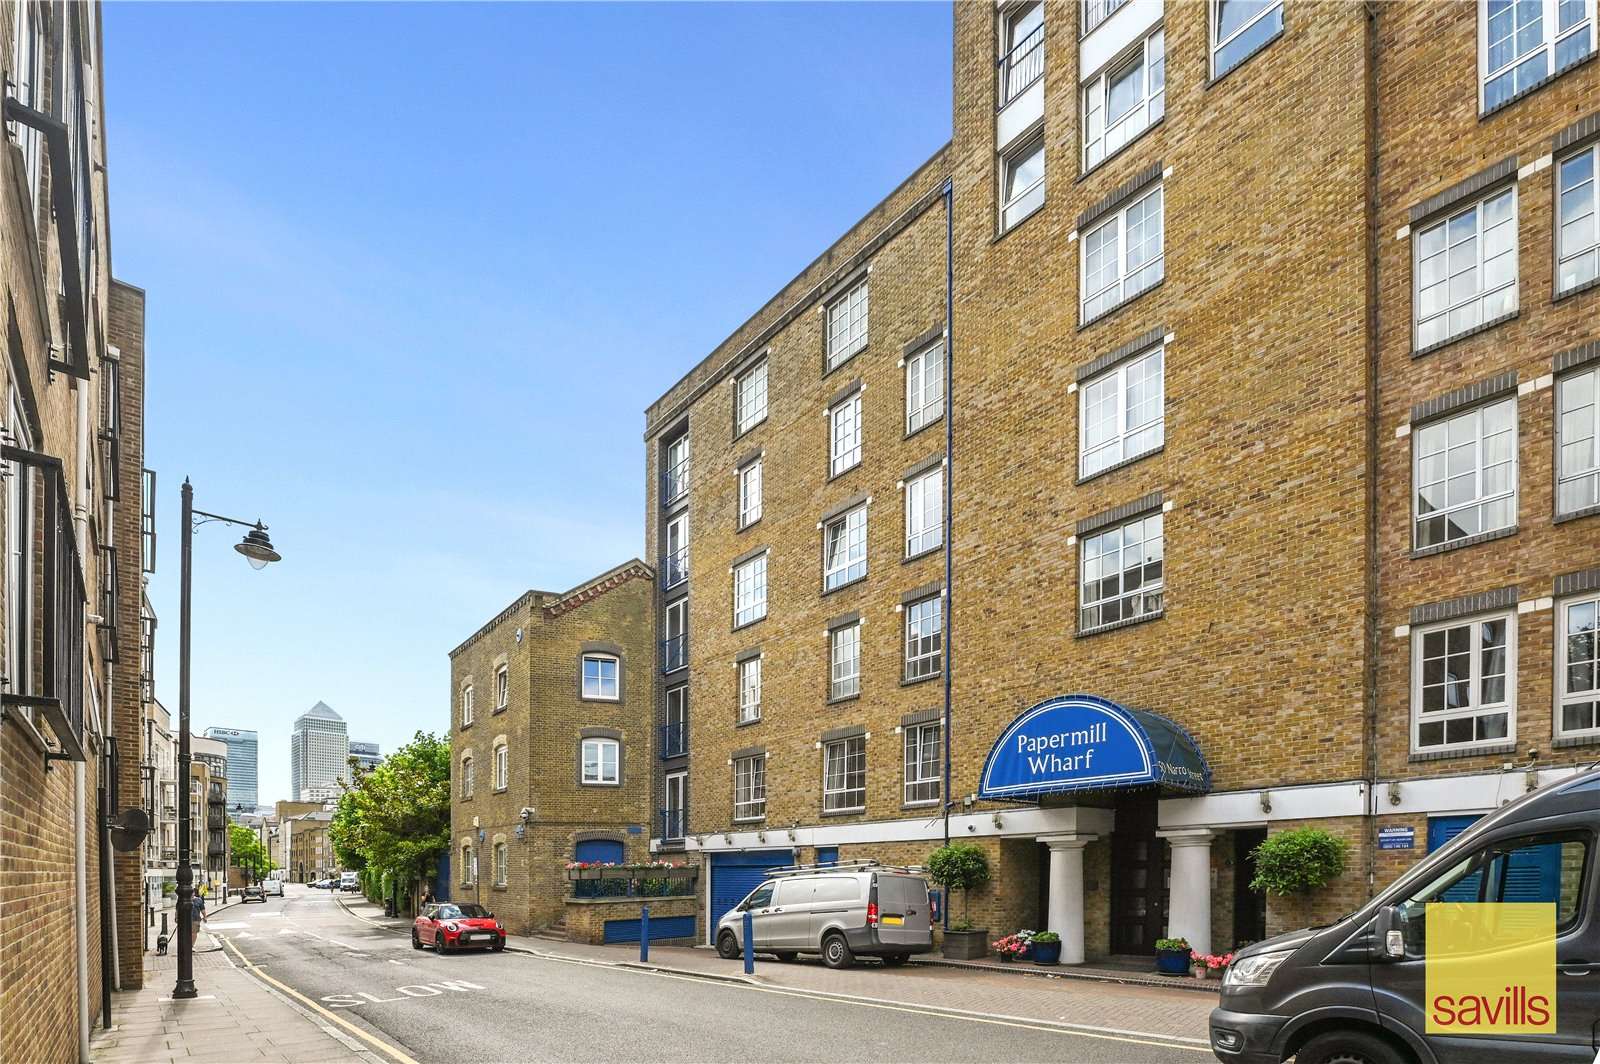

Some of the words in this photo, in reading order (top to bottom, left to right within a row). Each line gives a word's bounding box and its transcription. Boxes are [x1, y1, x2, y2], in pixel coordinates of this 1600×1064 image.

[1017, 721, 1107, 754] Papermill
[1028, 749, 1094, 775] Wharf
[320, 979, 487, 1008] SLOW
